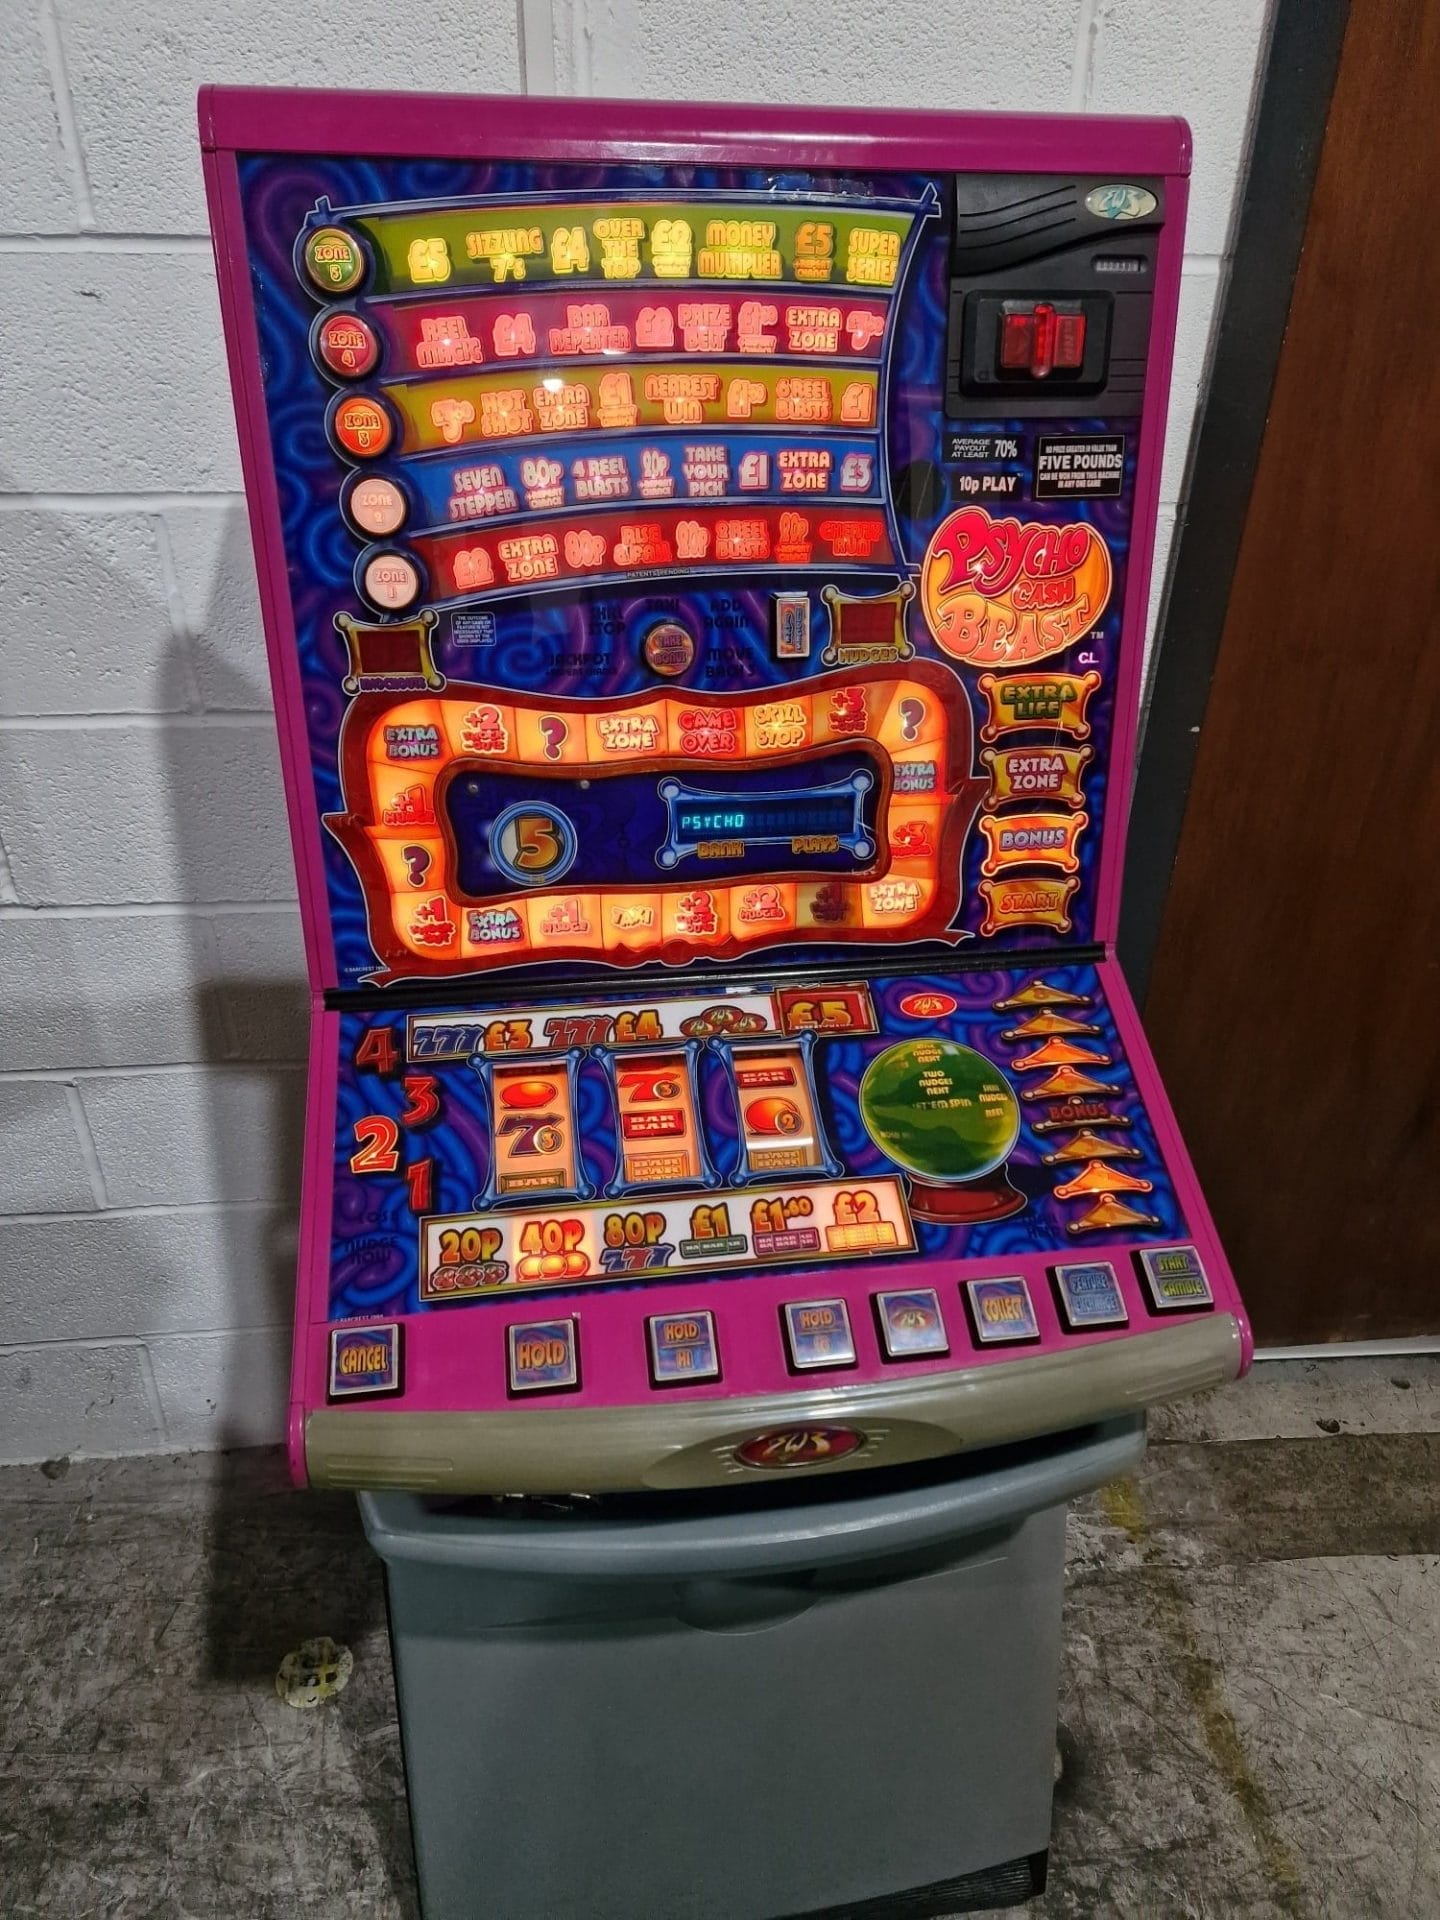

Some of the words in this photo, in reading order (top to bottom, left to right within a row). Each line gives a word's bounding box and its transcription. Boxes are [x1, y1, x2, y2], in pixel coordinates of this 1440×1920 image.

[593, 218, 644, 239] OVER
[707, 221, 776, 248] MONEY
[602, 240, 638, 258] THE
[796, 222, 834, 257] £5
[849, 228, 900, 256] SUPER
[315, 245, 351, 263] ZONE
[409, 238, 451, 282] £5
[329, 264, 342, 282] 5
[601, 258, 640, 278] TOP
[847, 257, 897, 286] SERIES
[567, 304, 610, 328] BAR
[678, 304, 731, 329] PRIZE
[787, 307, 841, 329] EXTRA
[329, 329, 365, 349] ZONE
[550, 326, 631, 354] REPEATER
[790, 330, 837, 351] ZONE
[341, 349, 355, 368] 4
[534, 384, 589, 408] EXTRA
[644, 374, 720, 400] NEAREST
[790, 378, 830, 399] REEL
[482, 390, 525, 414] HOT
[664, 399, 702, 423] WIN
[344, 413, 381, 431] ZONE
[481, 409, 533, 437] SHOT
[539, 406, 587, 430] ZONE
[685, 447, 726, 462] TAKE
[994, 439, 1018, 458] 70%
[572, 461, 586, 477] 4
[588, 457, 626, 477] REEL
[778, 451, 831, 469] EXTRA
[1039, 455, 1072, 470] FIVE
[1073, 454, 1123, 469] POUNDS
[454, 465, 504, 493] SEVEN
[684, 463, 728, 480] YOUR
[740, 454, 770, 490] £1
[781, 471, 829, 491] ZONE
[575, 476, 630, 498] BLASTS
[689, 481, 724, 497] PICK
[960, 476, 980, 495] 10p
[982, 476, 1017, 492] PLAY
[361, 492, 392, 506] ZONE
[450, 489, 517, 521] STEPPER
[621, 526, 661, 546] RISE
[730, 521, 768, 541] REEL
[499, 534, 558, 561] EXTRA
[932, 507, 1090, 596] PSYCHO
[374, 570, 408, 585] ZONE
[506, 555, 558, 581] ZONE
[627, 570, 657, 578] PATENTS
[1011, 577, 1075, 610] CASH
[935, 592, 1090, 663] BEAST
[657, 634, 683, 648] TAKE
[838, 647, 898, 663] NUDGES
[1001, 683, 1077, 702] EXTRA
[464, 705, 500, 730] +2
[755, 704, 806, 725] SKILL
[901, 698, 926, 741] ?
[1014, 701, 1061, 719] LIFE
[599, 715, 658, 736] EXTRA
[679, 709, 736, 732] GAME
[385, 725, 439, 742] EXTRA
[539, 715, 568, 760] ?
[604, 732, 657, 750] ZONE
[680, 731, 735, 753] OVER
[756, 726, 805, 749] STOP
[386, 742, 440, 759] BONUS
[894, 760, 936, 777] EXTRA
[1007, 755, 1066, 774] EXTRA
[894, 776, 935, 793] BONUS
[1011, 773, 1060, 791] ZONE
[682, 814, 745, 829] PSYCHO
[513, 816, 559, 868] 5
[1001, 829, 1065, 849] BONUS
[402, 844, 432, 887] ?
[745, 885, 780, 909] +2
[870, 881, 920, 898] EXTRA
[414, 896, 447, 922] +1
[679, 890, 713, 914] +2
[873, 896, 917, 912] ZONE
[1000, 891, 1059, 911] START
[468, 908, 518, 926] EXTRA
[740, 907, 785, 922] NUDGES
[469, 925, 521, 942] BONUS
[483, 1020, 532, 1050] £3
[615, 1010, 663, 1042] £4
[788, 1001, 853, 1030] £5
[357, 1028, 398, 1073] 4
[919, 1078, 953, 1087] NUDGES
[923, 1070, 945, 1078] TWO
[403, 1076, 439, 1126] 3
[926, 1087, 950, 1096] NEXT
[948, 1098, 972, 1107] SPIN
[1049, 1102, 1108, 1120] BONUS
[631, 1122, 676, 1130] BAR
[781, 1113, 796, 1129] 2
[350, 1115, 399, 1173] 2
[633, 1159, 678, 1167] BAR
[633, 1167, 679, 1175] BAR
[407, 1160, 433, 1210] 1
[508, 1176, 556, 1188] BAR
[751, 1196, 814, 1233] £1.60
[834, 1190, 881, 1225] £2
[603, 1211, 667, 1248] 80P
[690, 1203, 732, 1240] £1
[440, 1228, 503, 1265] 20P
[519, 1220, 584, 1254] 40P
[1158, 1253, 1189, 1271] START
[1163, 1279, 1204, 1297] GAMBLE
[801, 1310, 834, 1328] HOLD
[982, 1296, 1025, 1322] COLLECT
[664, 1323, 700, 1342] HOLD
[339, 1344, 388, 1375] CANCEL
[517, 1342, 567, 1370] HOLD
[676, 1350, 693, 1369] HI
